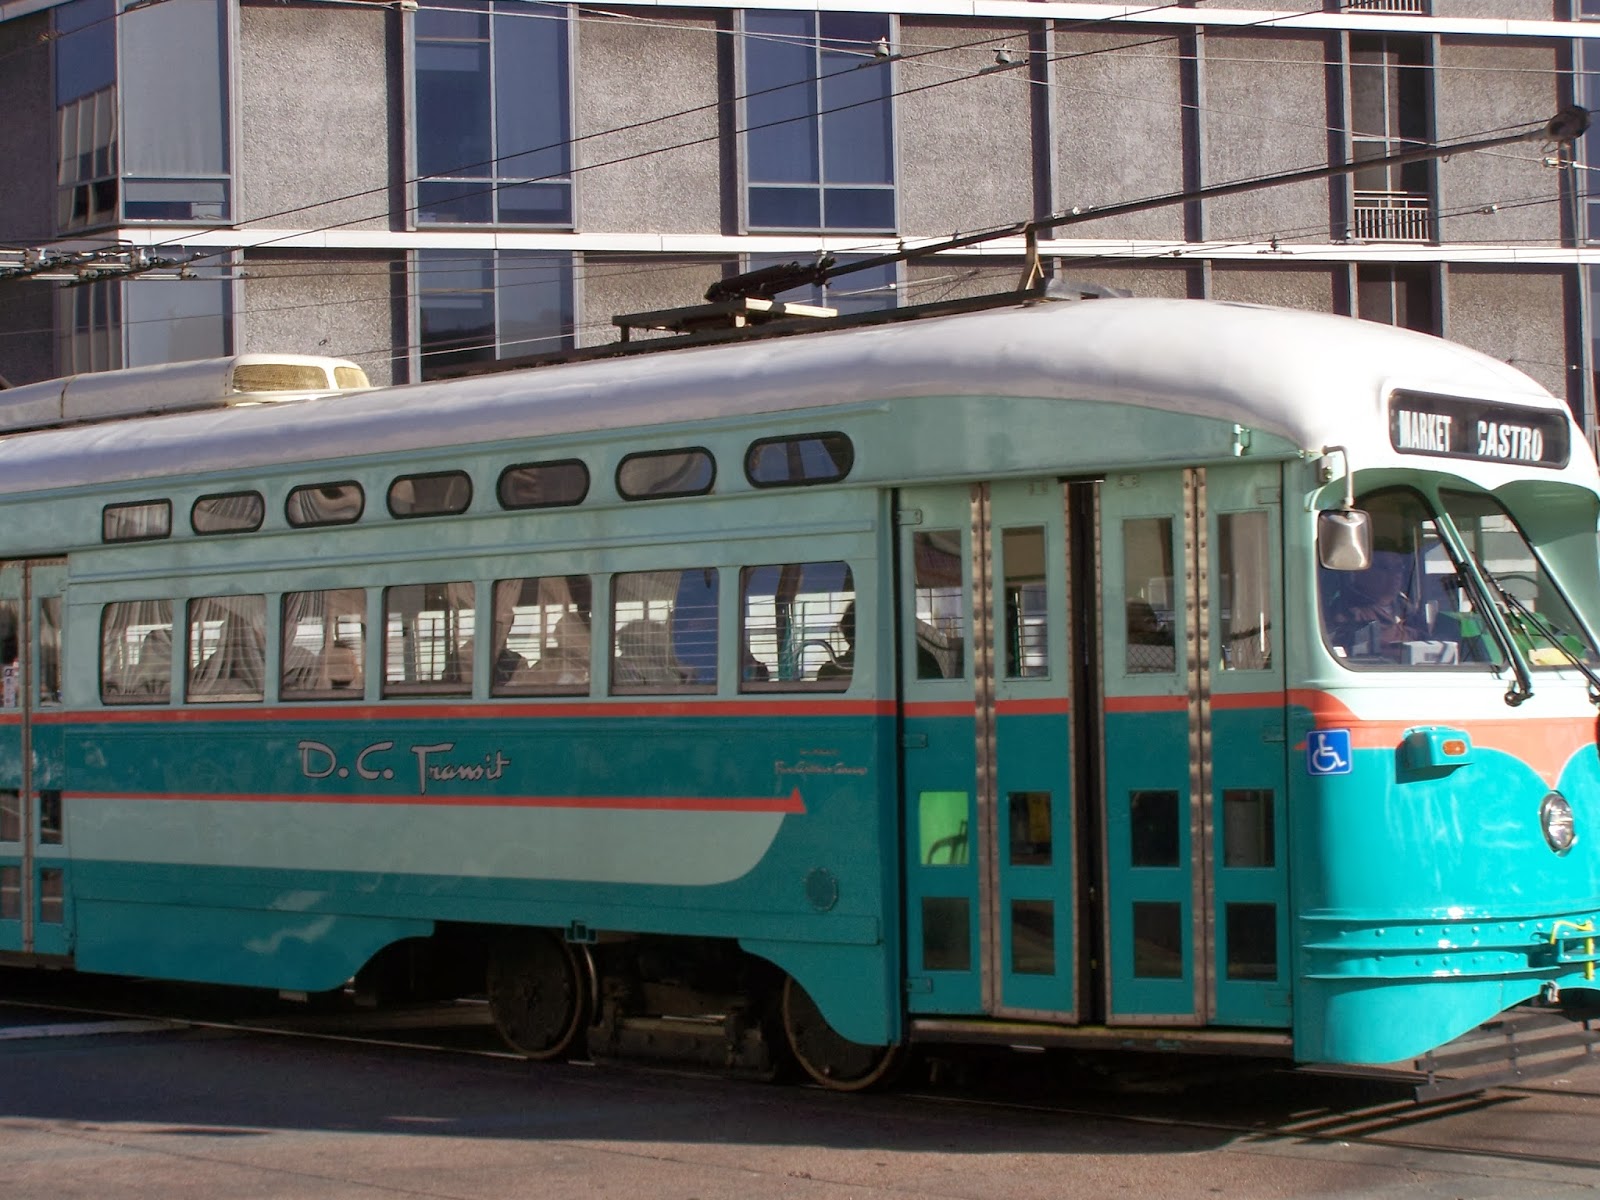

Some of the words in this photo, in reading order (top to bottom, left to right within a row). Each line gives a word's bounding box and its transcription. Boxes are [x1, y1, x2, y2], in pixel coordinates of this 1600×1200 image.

[1399, 410, 1452, 452] MARKET
[1477, 420, 1543, 461] CASTRO
[298, 740, 394, 779] D.C.
[410, 743, 510, 795] Transit
